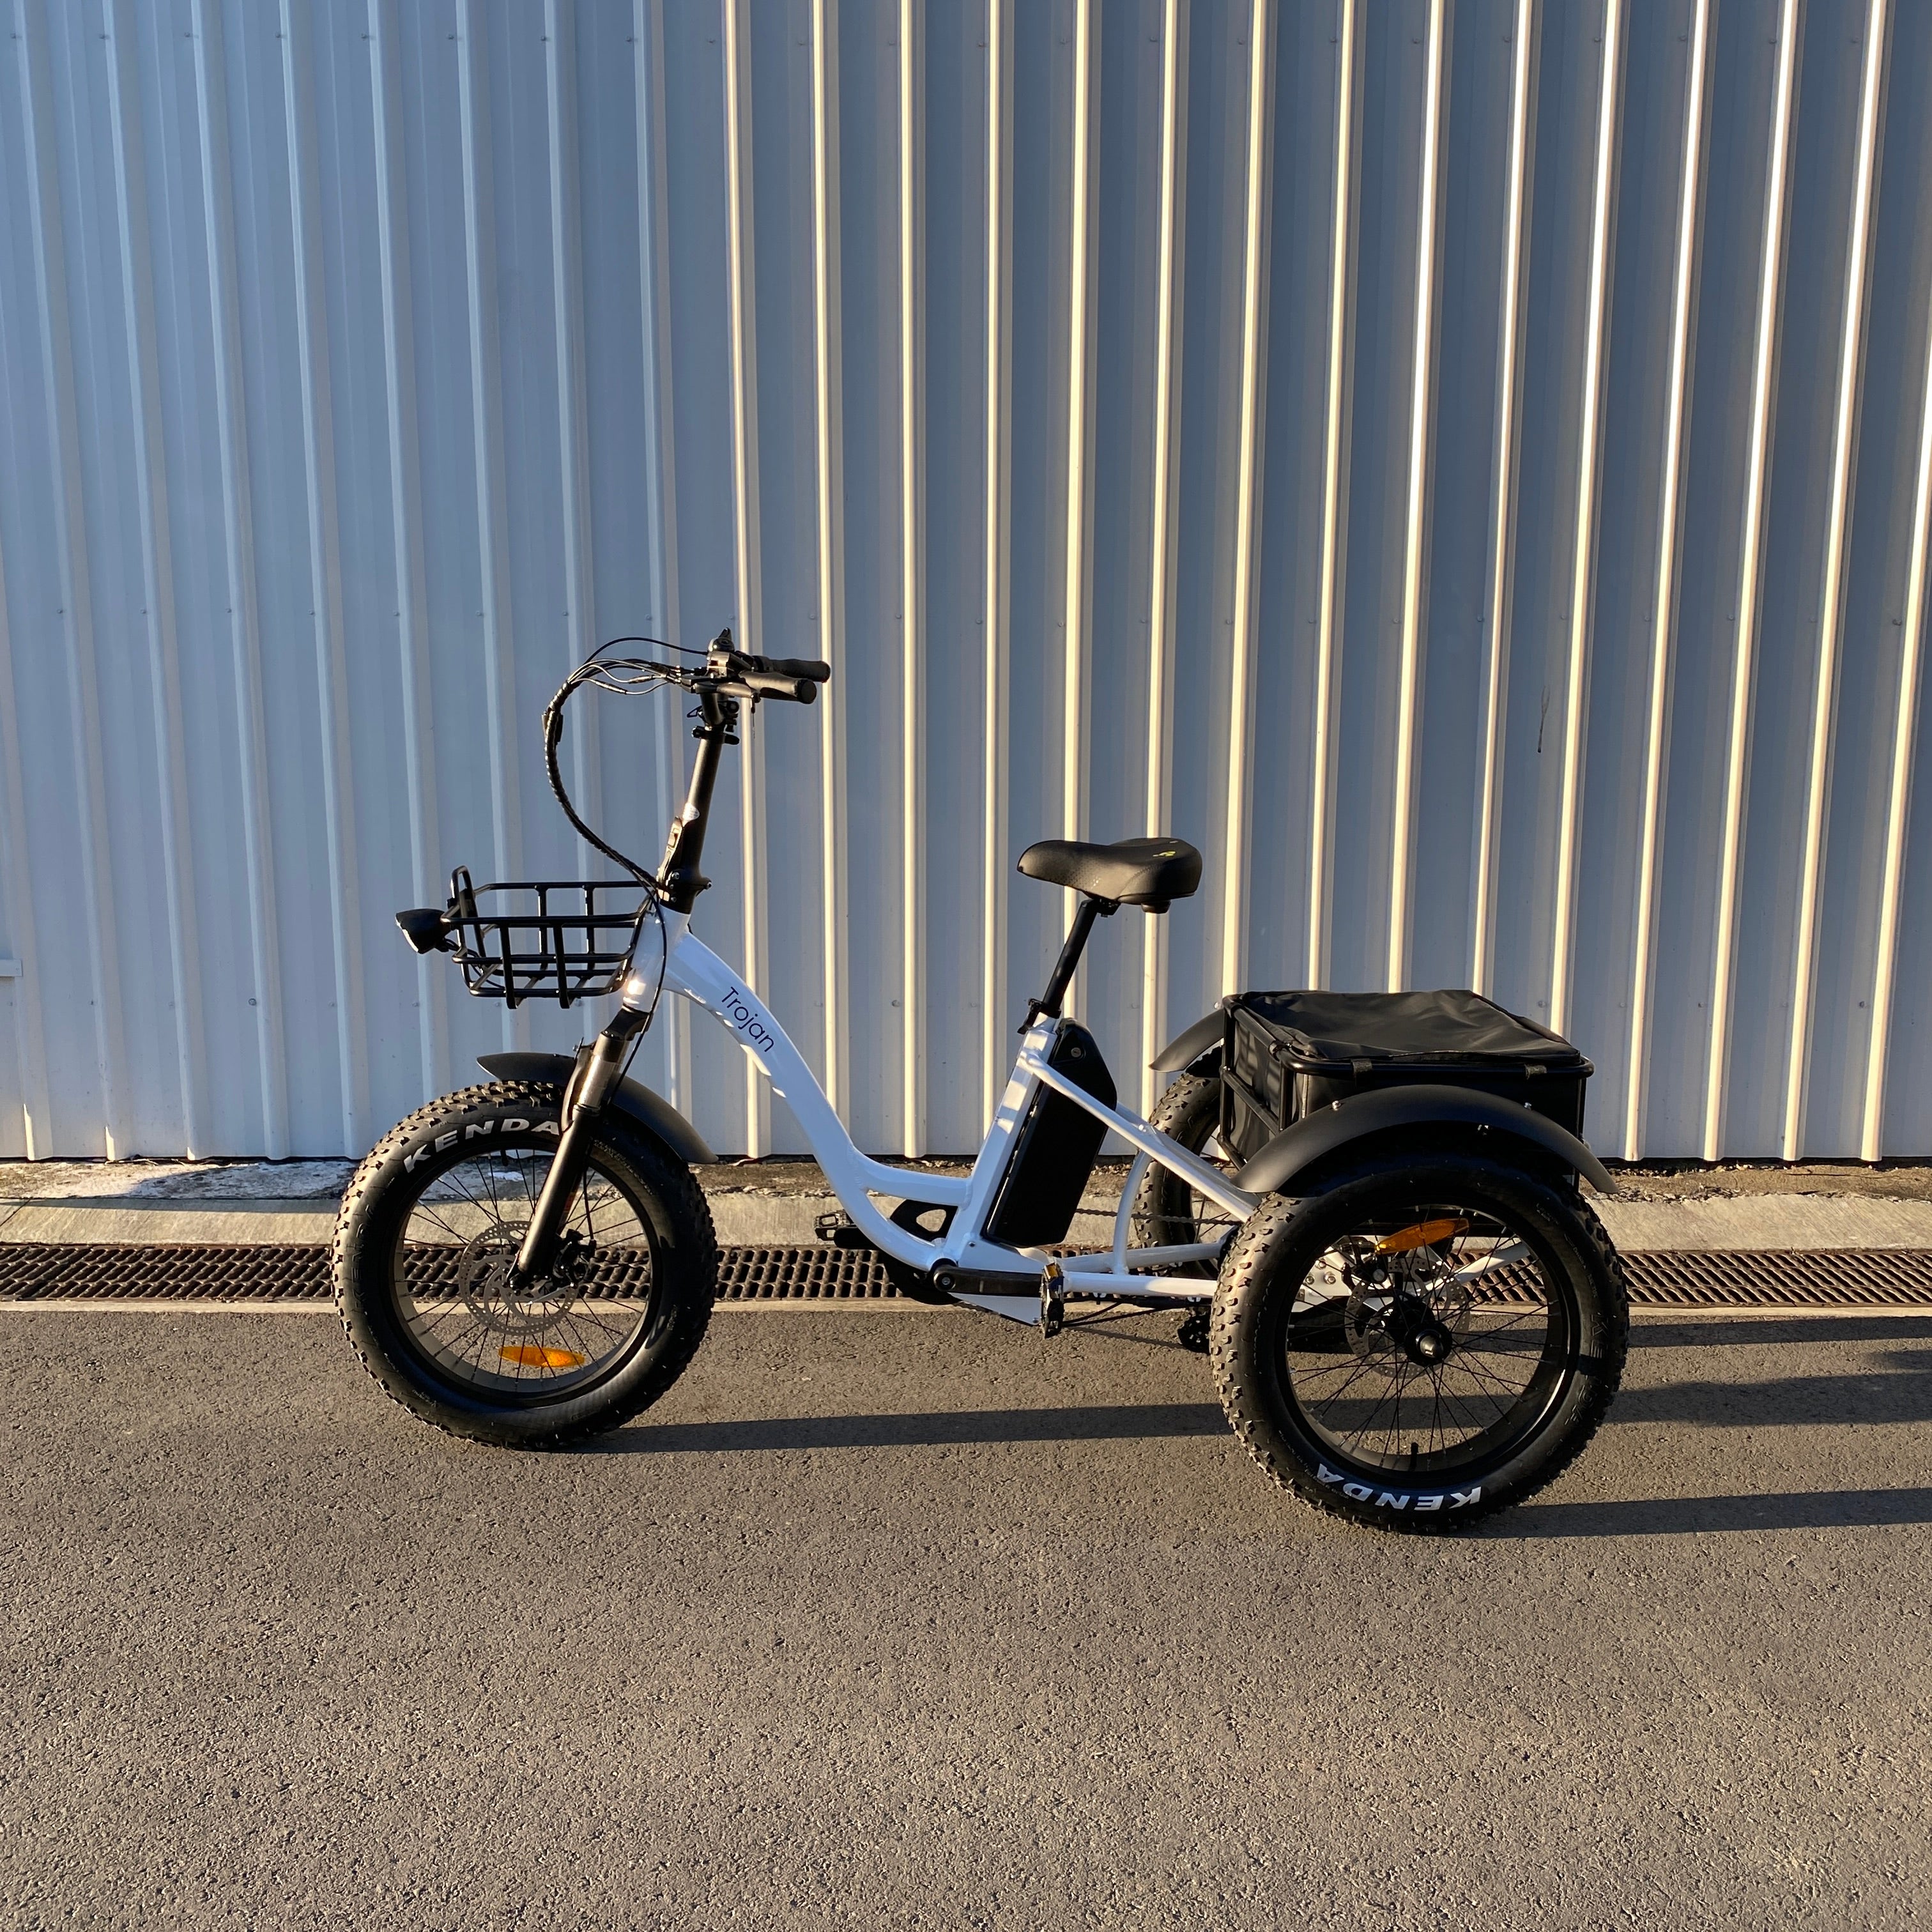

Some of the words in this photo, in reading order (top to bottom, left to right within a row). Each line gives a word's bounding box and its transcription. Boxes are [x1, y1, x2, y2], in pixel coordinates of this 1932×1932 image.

[721, 986, 774, 1052] Trojan
[403, 1118, 560, 1174] KENDA
[1317, 1463, 1482, 1511] KENDA
